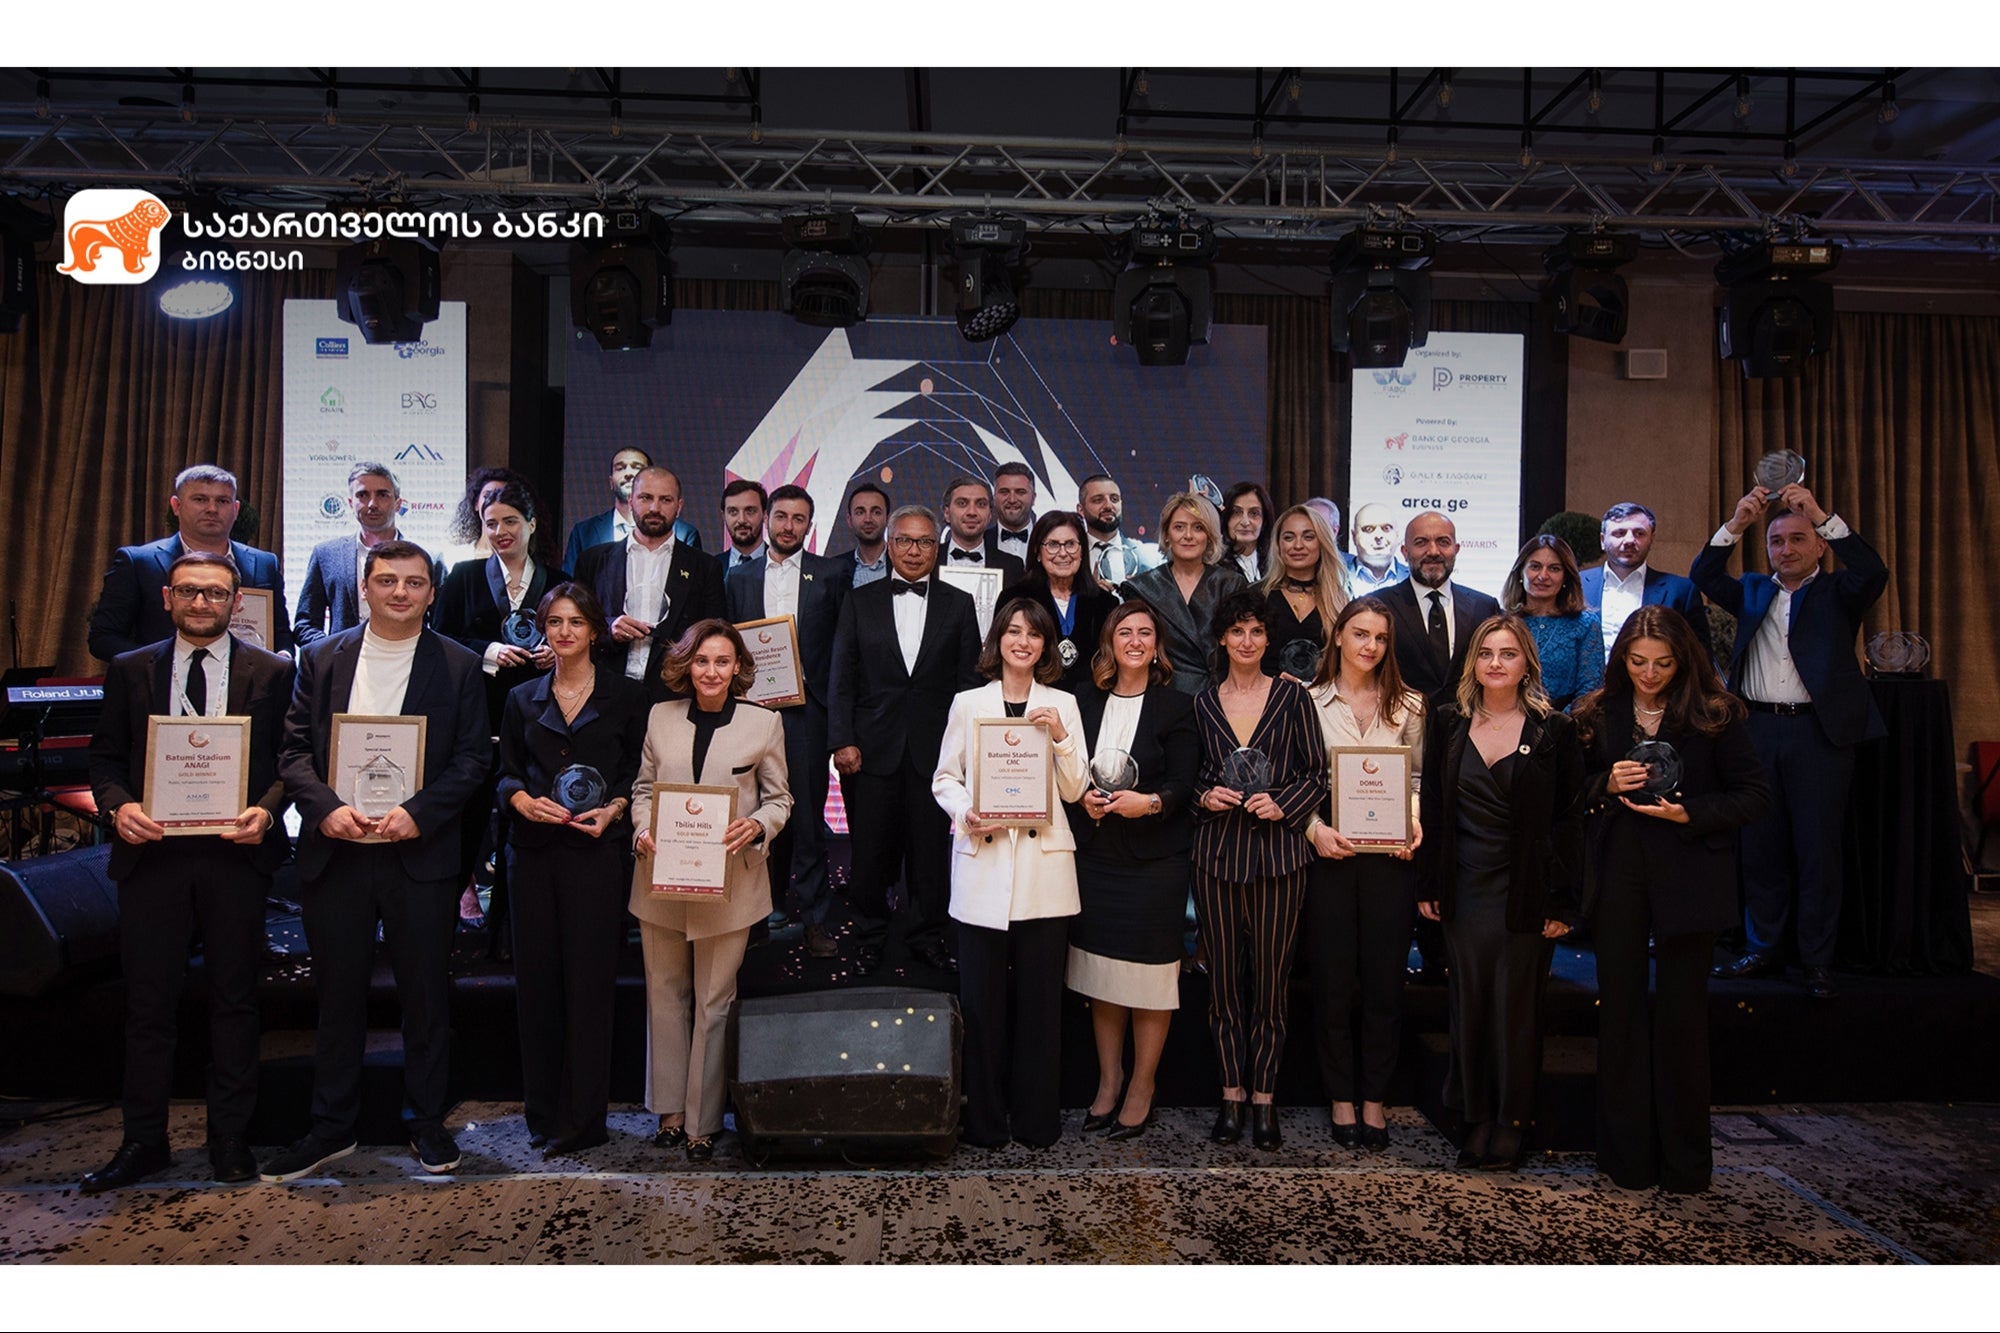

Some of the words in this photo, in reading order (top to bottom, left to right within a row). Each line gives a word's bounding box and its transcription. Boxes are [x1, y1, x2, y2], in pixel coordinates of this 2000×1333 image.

[319, 340, 346, 348] Colliers
[1415, 350, 1450, 358] Organized
[1451, 350, 1462, 359] by:
[1459, 374, 1508, 383] PROPERTY
[1412, 435, 1436, 443] BANK
[1437, 435, 1449, 443] OF
[1451, 435, 1490, 444] GEORGIA
[411, 502, 445, 510] RE/MAX
[1402, 498, 1468, 512] area.ge
[1460, 540, 1498, 549] AWARDS
[22, 689, 70, 699] Roland
[165, 753, 196, 761] Batumi
[197, 753, 231, 761] Stadium
[675, 821, 696, 829] Tbilisi
[696, 822, 712, 830] Hills
